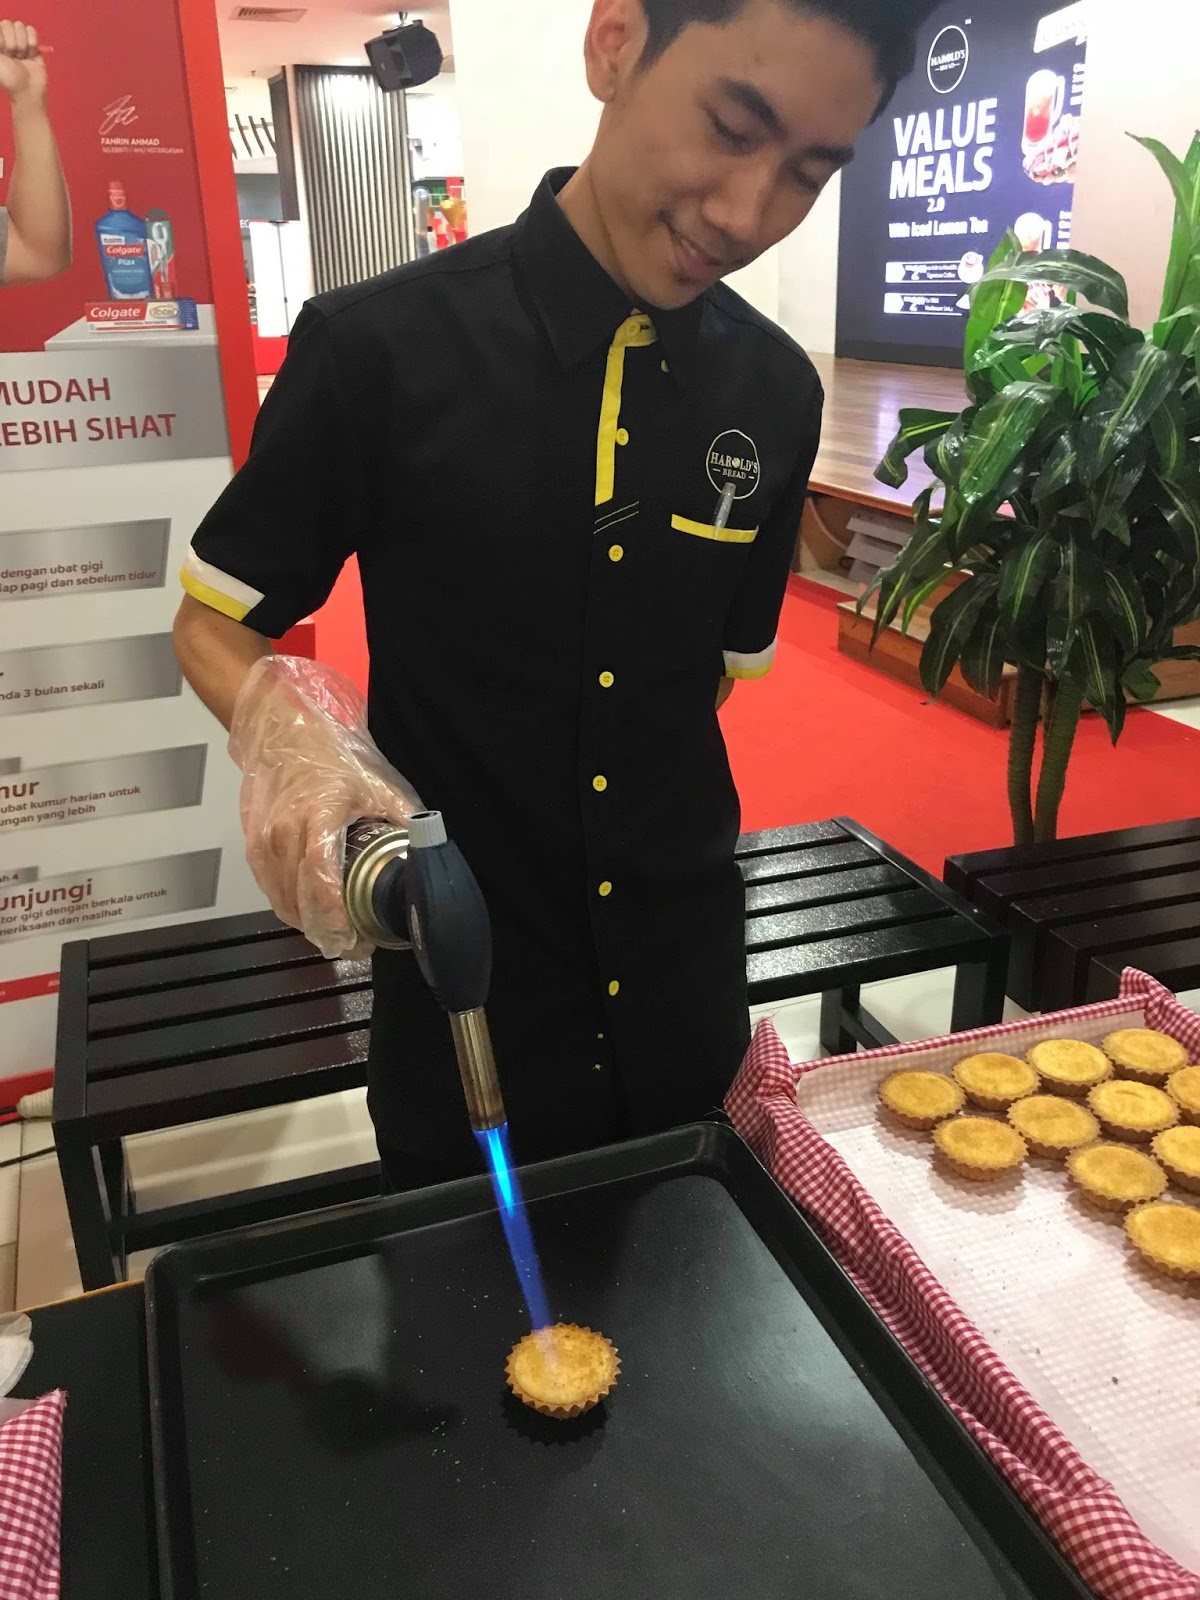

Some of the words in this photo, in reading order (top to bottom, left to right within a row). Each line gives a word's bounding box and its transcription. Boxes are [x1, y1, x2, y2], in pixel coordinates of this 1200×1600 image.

[893, 97, 998, 157] VALUE
[101, 137, 129, 145] FAHRIN
[131, 138, 160, 146] AHMAD
[889, 145, 993, 200] MEALS
[926, 196, 946, 213] 2.0
[106, 245, 142, 256] Colgate
[118, 258, 135, 266] Plax
[90, 306, 141, 319] Colgate
[0, 418, 77, 447] EBIH
[86, 413, 176, 442] SIHAT
[710, 451, 758, 474] HAROLD'S
[722, 468, 747, 480] BREAD
[0, 566, 47, 579] dengan
[50, 561, 78, 575] ubat
[80, 560, 104, 573] gigi
[20, 579, 48, 592] pagi
[51, 576, 74, 588] dan
[76, 573, 126, 586] sebelum
[129, 570, 156, 581] tidur
[23, 689, 31, 698] 3
[34, 685, 68, 697] bulan
[70, 680, 105, 692] sekali
[0, 803, 28, 814] ubat
[30, 796, 68, 810] kumur
[70, 791, 106, 803] harian
[108, 785, 141, 798] untuk
[36, 809, 65, 823] yang
[67, 804, 96, 816] lebih
[0, 915, 17, 925] tor
[20, 910, 43, 923] gigi
[46, 902, 89, 917] dengan
[91, 894, 133, 908] berkala
[135, 888, 168, 900] untuk
[58, 915, 79, 926] dan
[81, 907, 123, 922] nasihat
